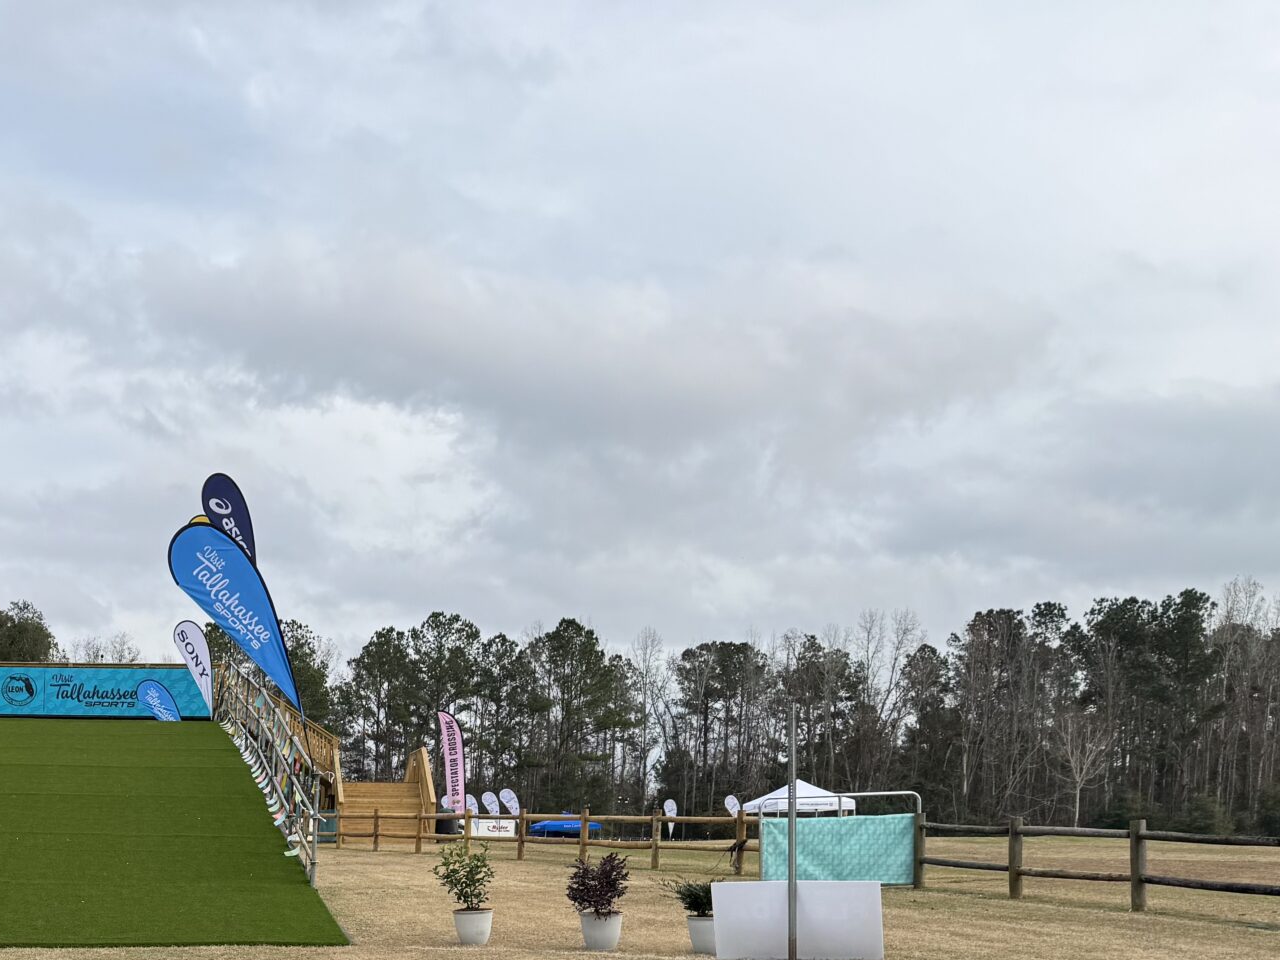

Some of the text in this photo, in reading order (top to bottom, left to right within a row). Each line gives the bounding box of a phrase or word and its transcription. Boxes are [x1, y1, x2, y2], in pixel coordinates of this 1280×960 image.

[222, 516, 252, 557] asi
[203, 545, 226, 570] Visit
[192, 551, 271, 644] Tallahassee
[212, 602, 262, 650] SPORTS
[176, 629, 210, 679] SONY
[8, 685, 24, 694] LEON
[49, 682, 137, 703] Tallahassee
[51, 673, 74, 683] Visit
[445, 720, 459, 797] SPECTATOR CROSSING
